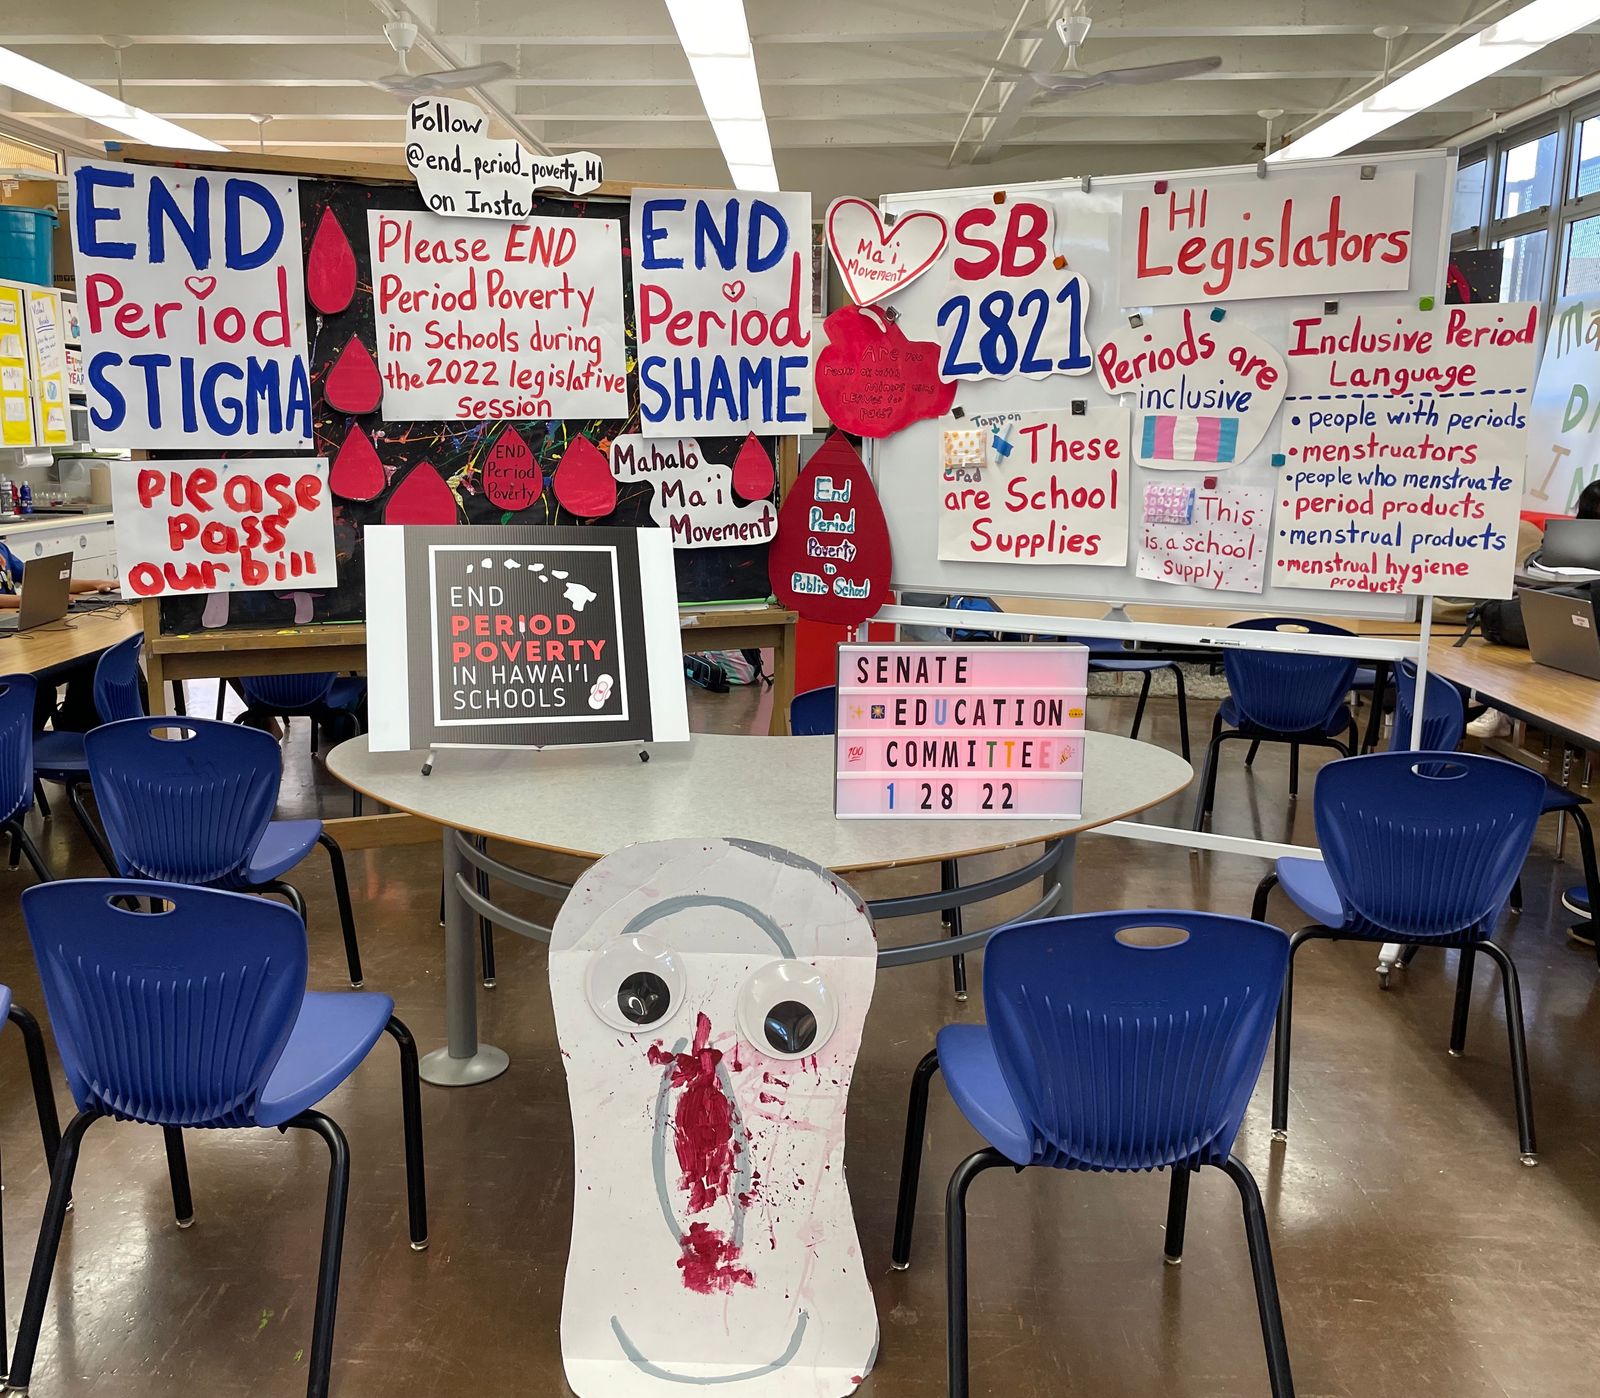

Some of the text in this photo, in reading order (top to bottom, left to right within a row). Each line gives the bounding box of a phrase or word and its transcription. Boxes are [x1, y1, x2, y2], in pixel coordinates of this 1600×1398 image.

[411, 101, 484, 134] Follow
[74, 166, 285, 270] END
[429, 190, 528, 217] on Insta
[1168, 188, 1208, 231] HI
[377, 215, 577, 267] Please END
[641, 198, 790, 273] END
[954, 203, 1048, 281] SB
[1136, 196, 1410, 296] Legislators
[846, 259, 907, 282] Movement
[86, 266, 291, 348] Period
[379, 267, 595, 328] Period Poverty
[639, 251, 810, 349] Period
[936, 277, 1091, 375] 2821
[1288, 305, 1538, 356] Inclusive Period
[388, 319, 601, 367] in Schools during
[1098, 309, 1279, 391] Periods are
[383, 358, 626, 399] the 2022 legislative
[640, 355, 808, 423] SHAME
[1136, 374, 1254, 412] inclusive
[1329, 360, 1477, 396] Language
[89, 351, 313, 439] STIGMA
[970, 413, 1021, 427] Tampon
[1308, 400, 1526, 434] people with periods
[496, 444, 525, 459] END
[613, 441, 699, 476] Mahalo
[1018, 422, 1121, 464] These
[1302, 431, 1478, 465] menstruators
[487, 458, 535, 480] Period
[956, 467, 982, 483] Pad
[1295, 464, 1513, 492] people who menstruate
[487, 482, 535, 505] Poverty
[816, 477, 850, 502] End
[944, 468, 1118, 513] are School
[1295, 489, 1485, 520] period products
[810, 507, 855, 533] Period
[1199, 496, 1256, 524] This
[670, 511, 775, 546] Movement
[970, 517, 1101, 558] Supplies
[1144, 529, 1255, 561] is a school
[1289, 519, 1507, 554] menstrual products
[808, 538, 856, 561] Poverty
[127, 545, 317, 596] our bill
[824, 564, 835, 574] in
[1163, 559, 1224, 590] supply
[1286, 551, 1470, 584] menstrual hygiene
[450, 586, 504, 607] END
[793, 573, 869, 598] Public School
[1330, 575, 1404, 595] products
[451, 614, 576, 636] PERIOD
[452, 639, 606, 663] POVERTY
[453, 666, 476, 685] IN
[857, 656, 968, 684] SENATE
[453, 687, 566, 710] SCHOOLS
[895, 699, 1063, 726] EDUCATION
[886, 740, 1051, 768] COMMITTEE
[887, 782, 1013, 810] 1 28 22
